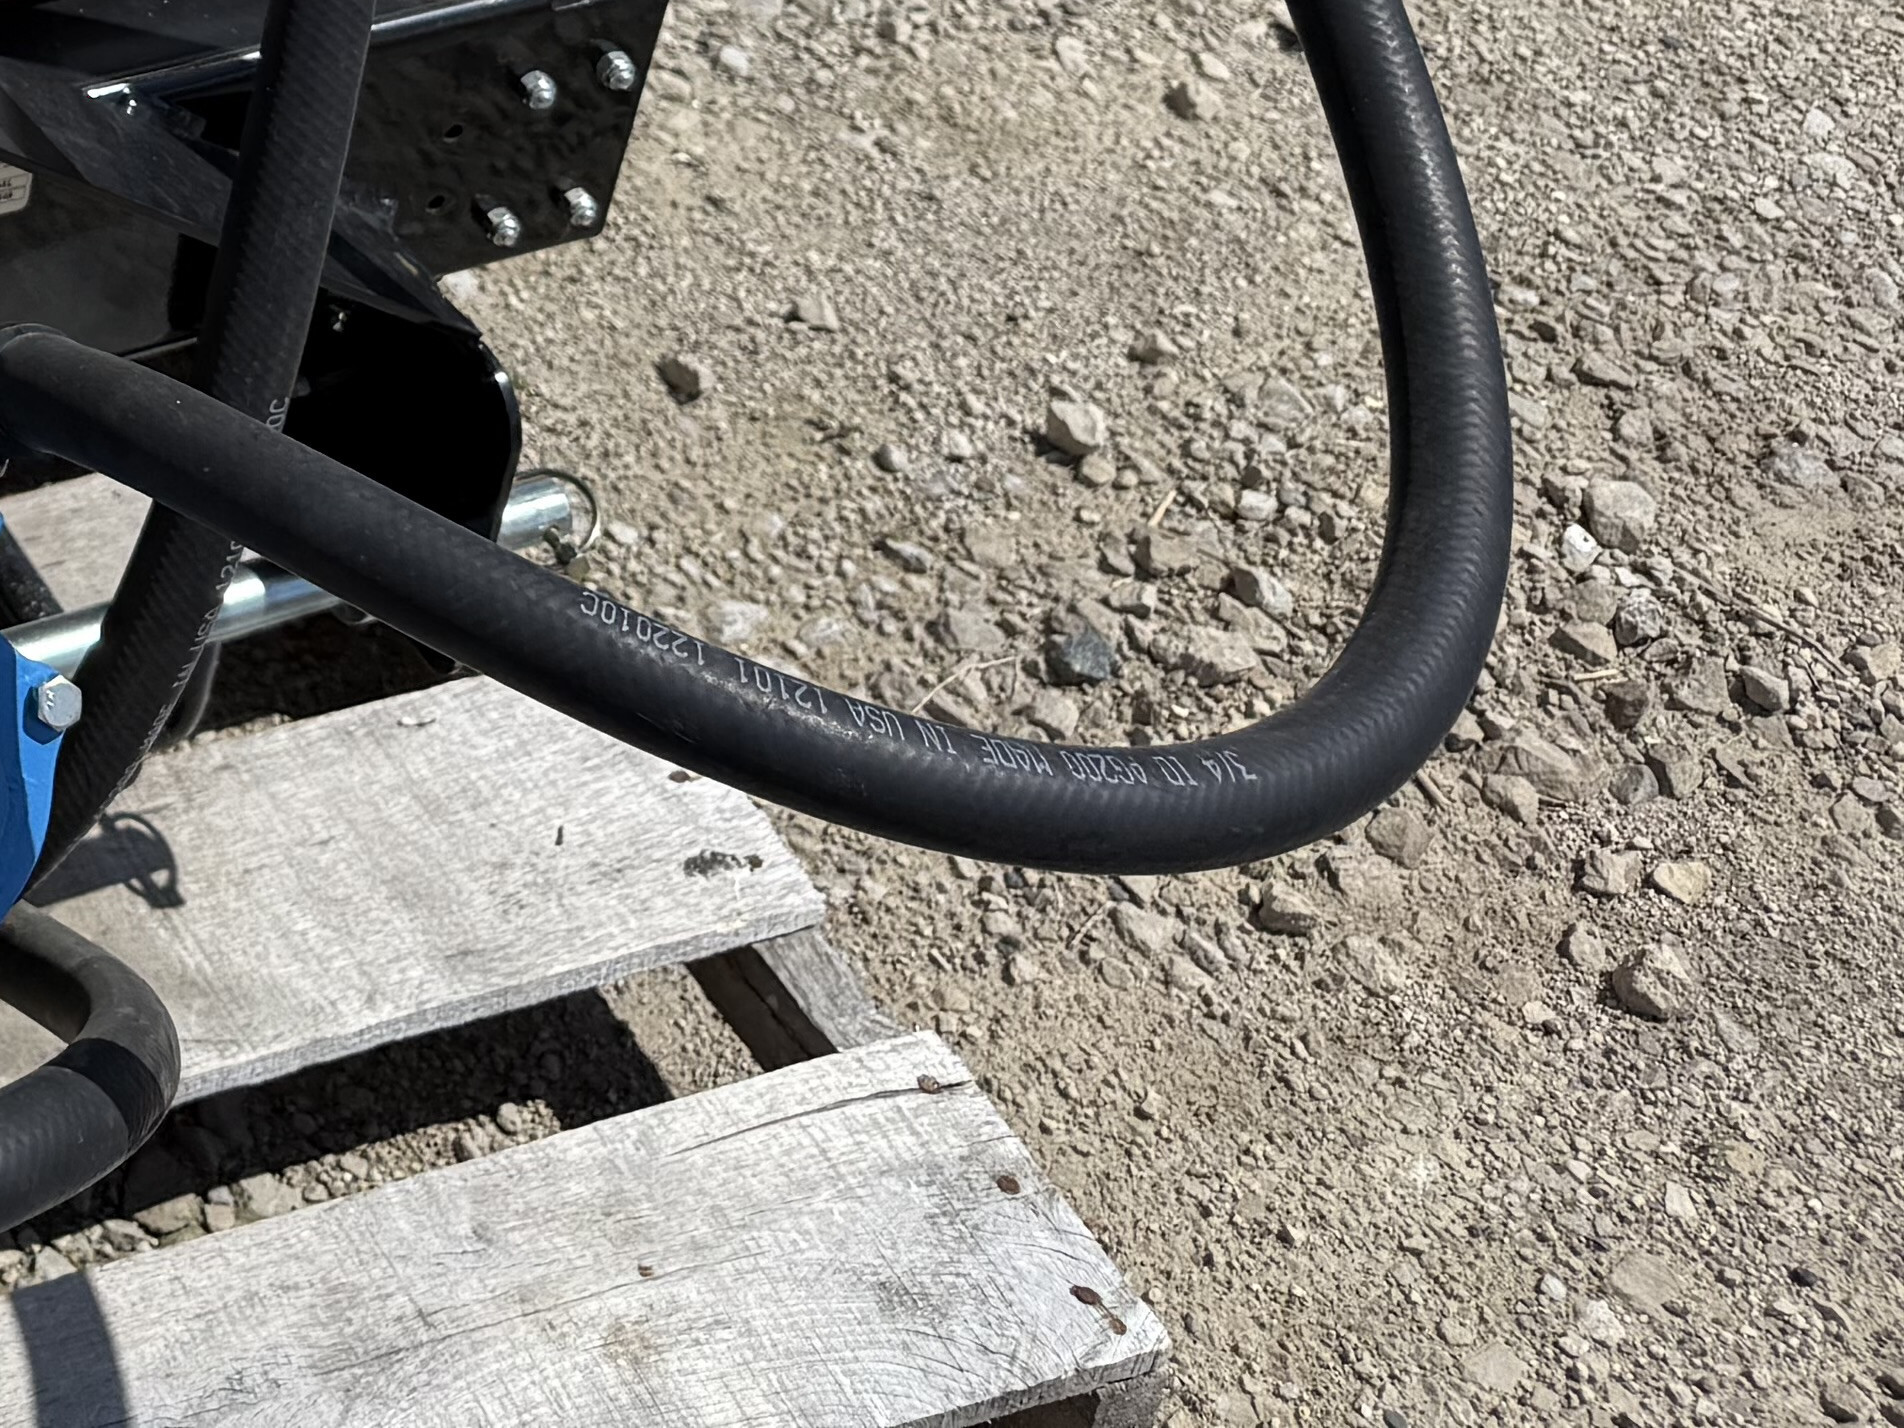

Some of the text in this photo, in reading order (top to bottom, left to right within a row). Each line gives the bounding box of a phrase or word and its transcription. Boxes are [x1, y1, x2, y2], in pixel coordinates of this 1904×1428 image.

[580, 590, 1258, 787] 3/4 ID AG200 MADE IN USA 12101 122010C
